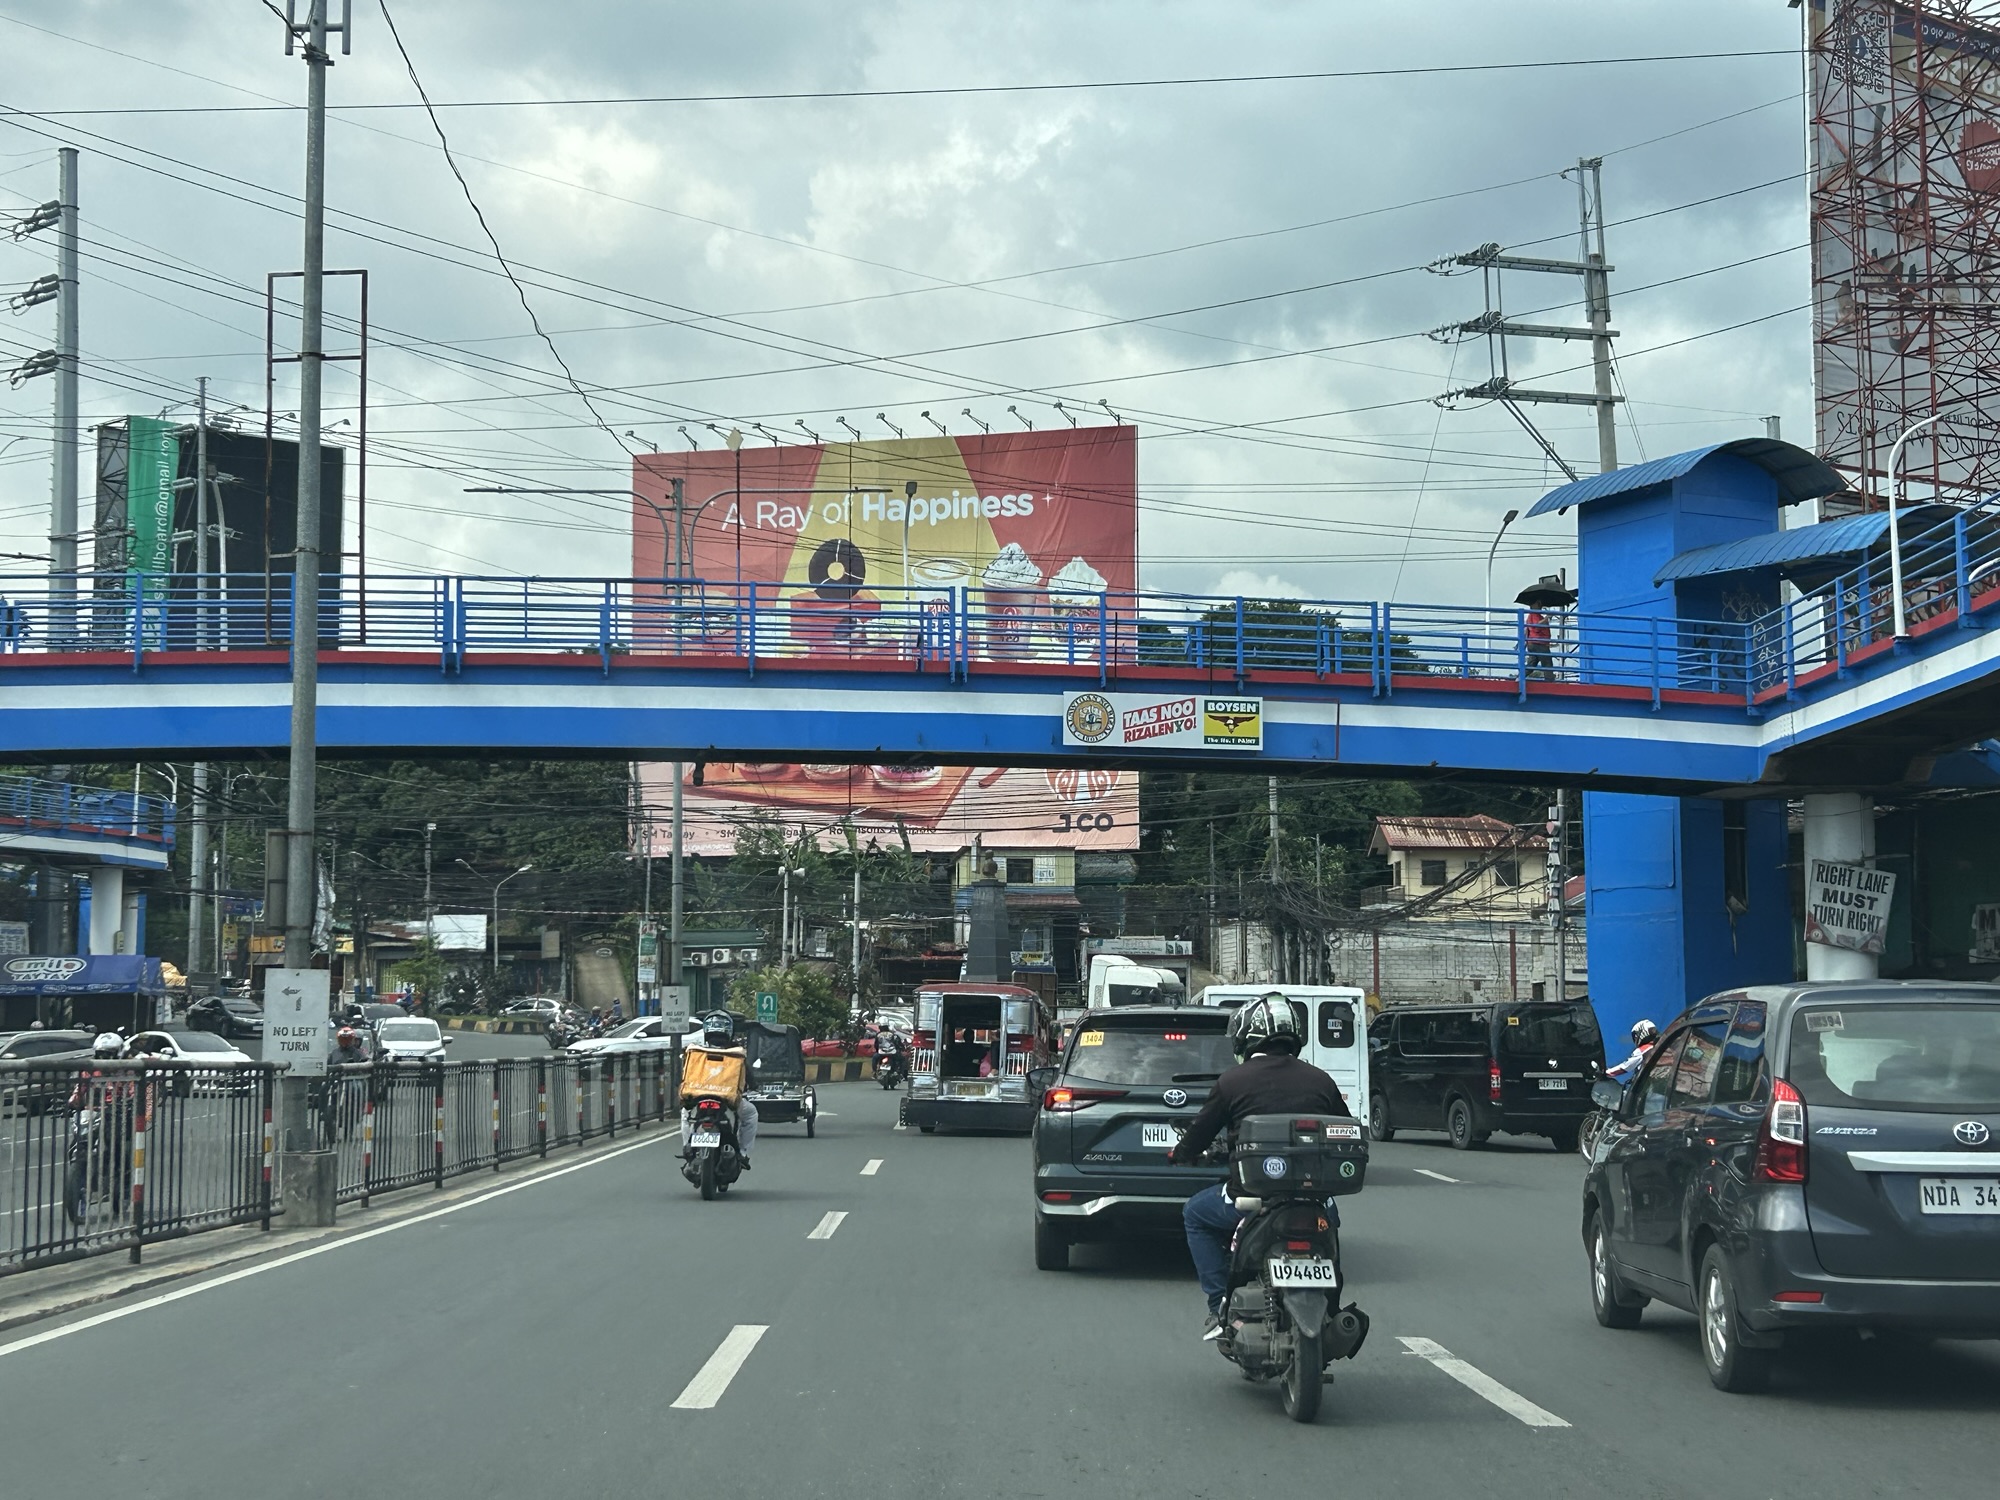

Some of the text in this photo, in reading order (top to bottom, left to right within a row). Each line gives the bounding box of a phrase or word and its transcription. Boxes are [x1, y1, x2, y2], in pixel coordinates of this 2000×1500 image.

[721, 490, 1034, 532] A Ray of Happiness
[1123, 700, 1195, 727] TAAS NOO
[1207, 702, 1257, 713] BOYSEN
[1124, 716, 1197, 743] RIZALENYO!
[662, 829, 695, 840] Taay
[829, 825, 886, 835] Ronsons
[1816, 863, 1890, 895] RIGHT LANE
[1822, 888, 1879, 911] MUST
[1813, 903, 1884, 934] TURN RIGHT
[273, 1026, 318, 1037] NO LEFT
[280, 1041, 310, 1052] TURN
[1144, 1128, 1168, 1142] NHU
[1816, 1126, 1878, 1136] AVANZA
[1083, 1153, 1122, 1161] AVANZA
[1923, 1185, 2000, 1207] NDA 34
[1273, 1265, 1332, 1281] U9448C
